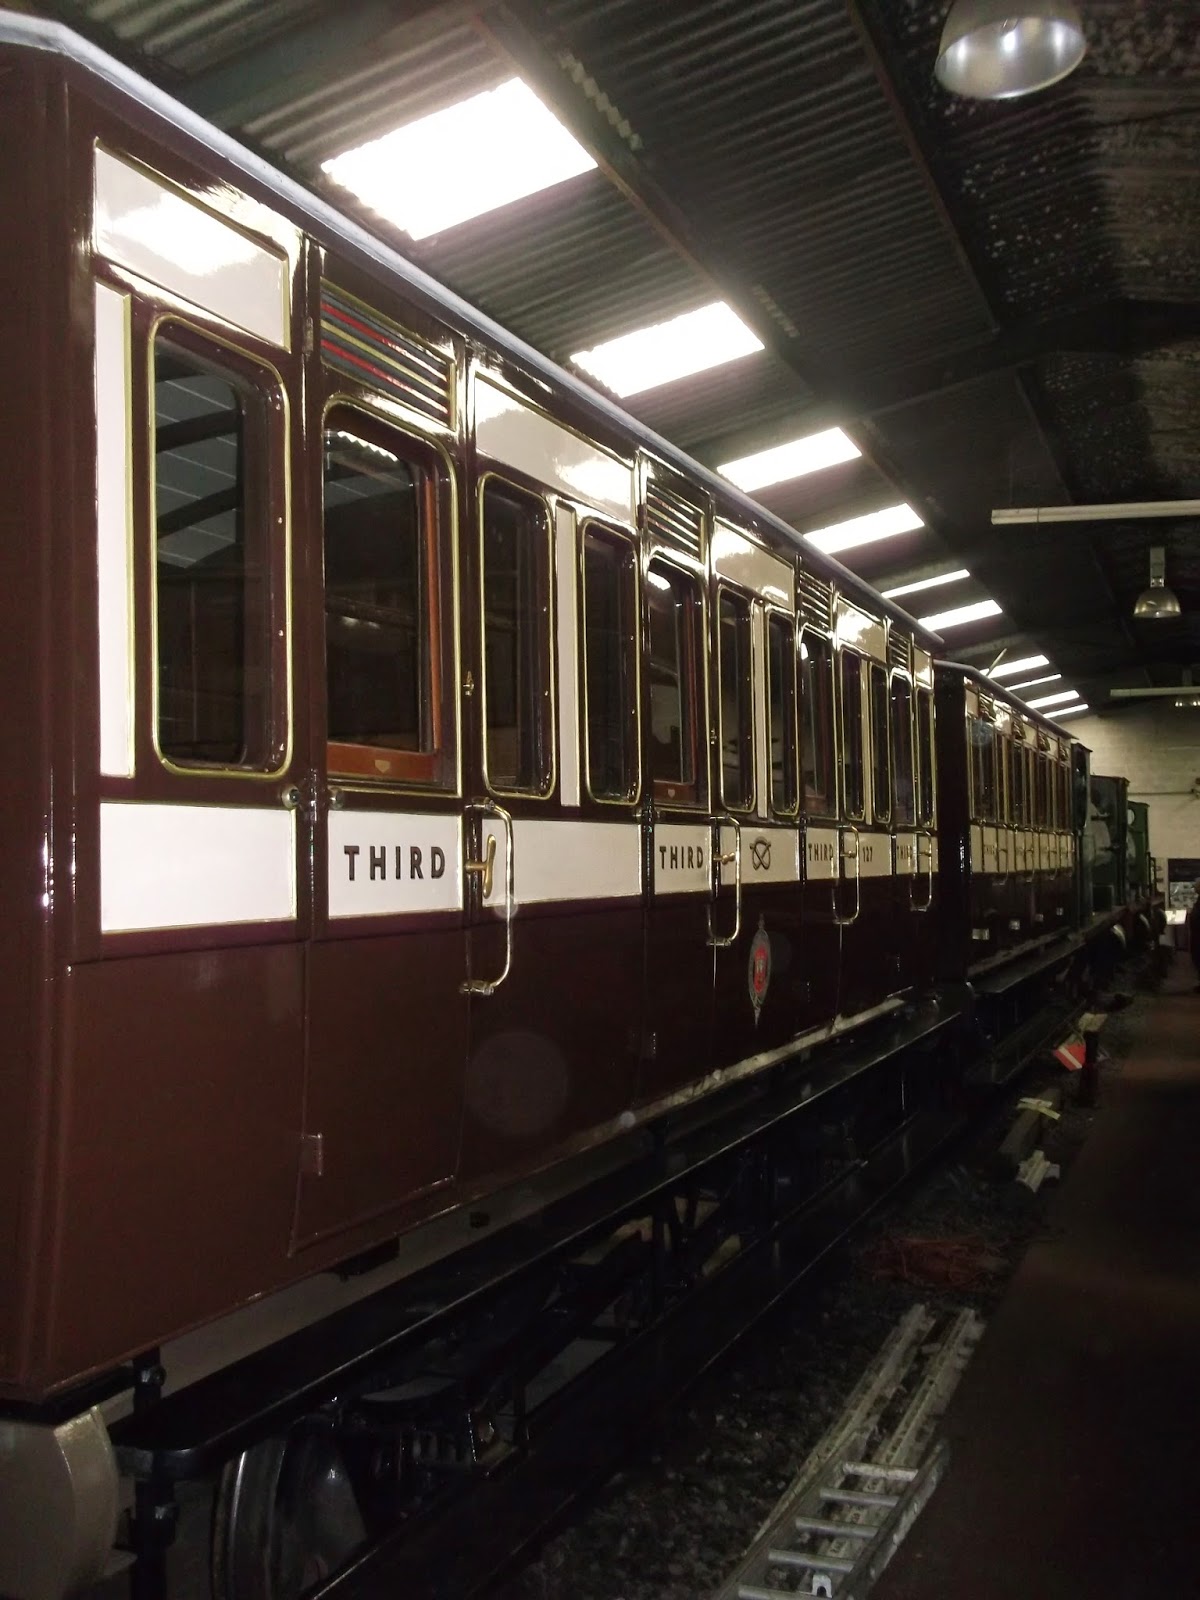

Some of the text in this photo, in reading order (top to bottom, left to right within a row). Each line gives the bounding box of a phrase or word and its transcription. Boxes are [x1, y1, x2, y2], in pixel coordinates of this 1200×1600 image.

[344, 845, 446, 881] THIRD
[659, 845, 704, 870] THIRD
[808, 843, 834, 862] THIRD
[862, 846, 873, 862] 127
